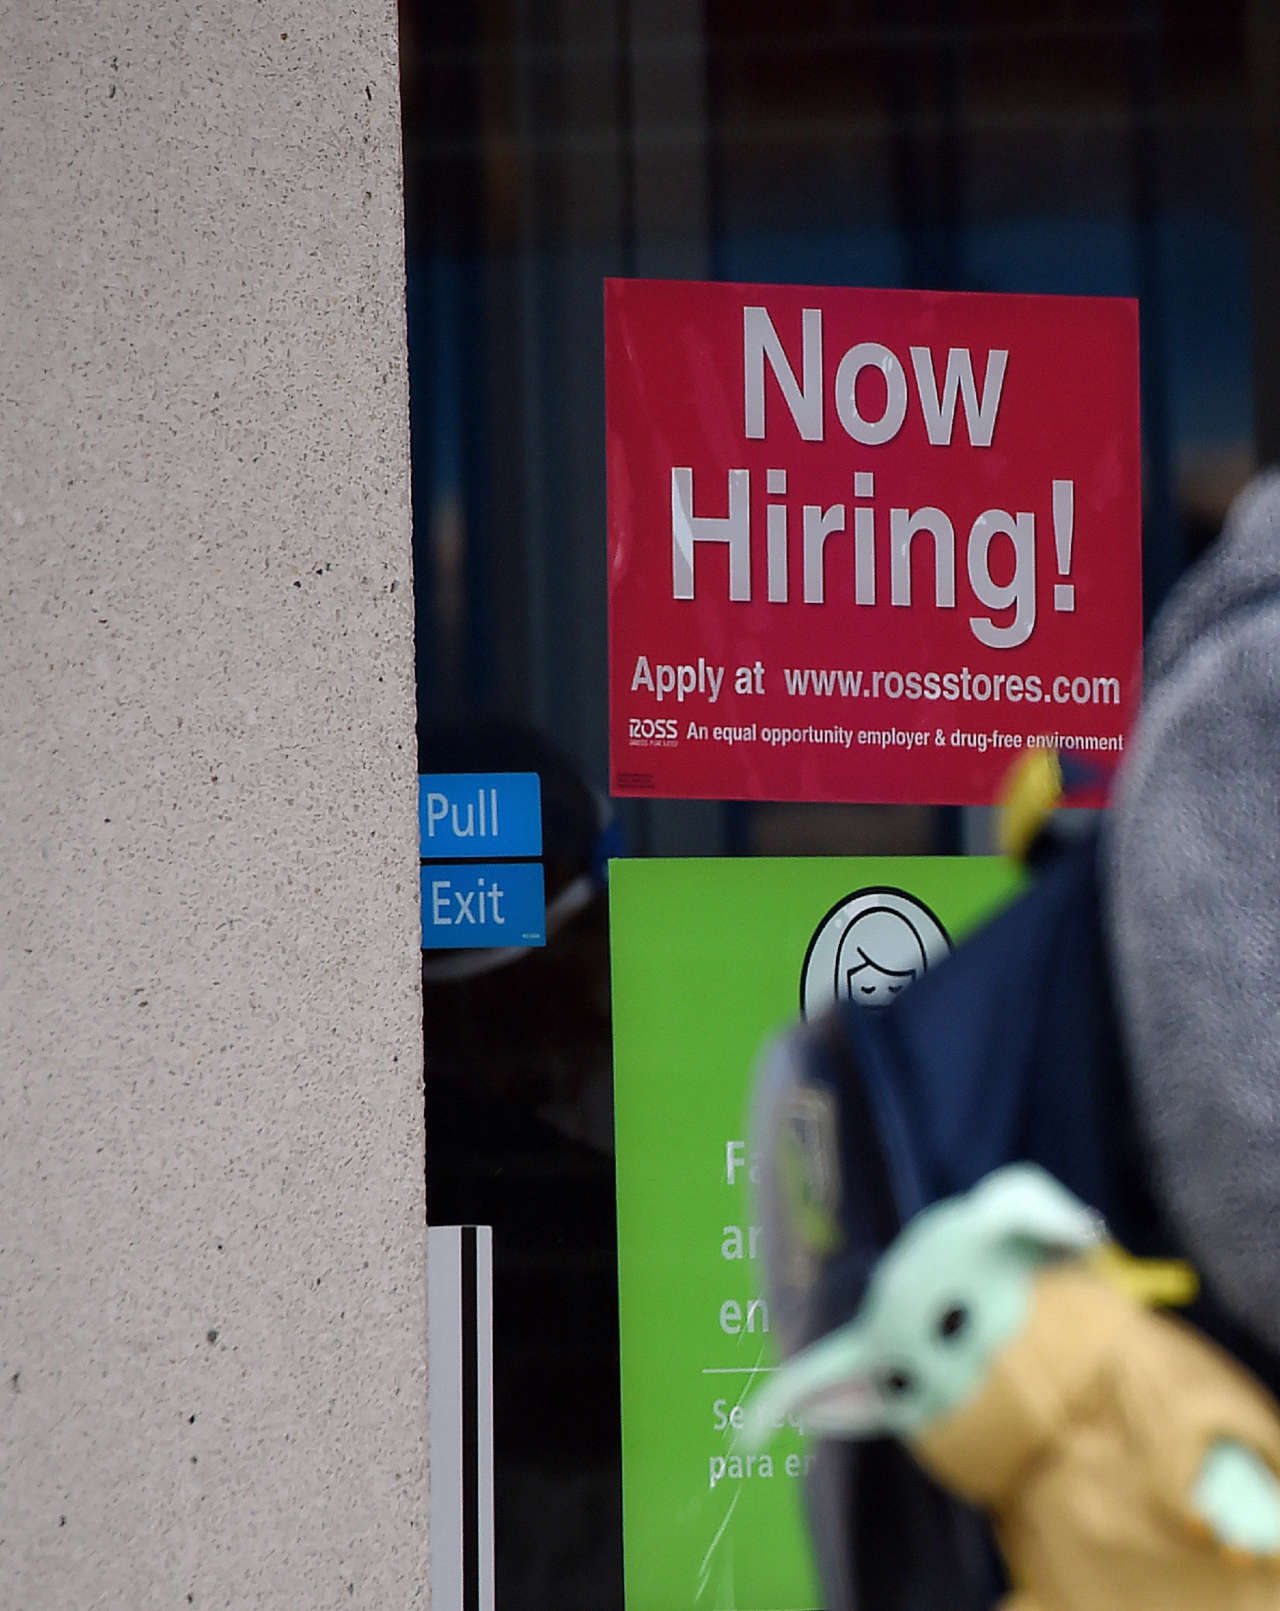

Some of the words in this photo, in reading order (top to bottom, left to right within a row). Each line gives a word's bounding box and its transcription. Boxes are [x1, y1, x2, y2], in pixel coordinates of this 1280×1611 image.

[744, 306, 1008, 446] Now
[672, 466, 1075, 649] Hiring!
[631, 655, 725, 703] Apply
[735, 661, 765, 695] at
[784, 667, 1121, 704] www.rossstores.com
[629, 719, 678, 739] ROSS
[686, 722, 708, 740] An
[713, 723, 757, 746] equal
[761, 726, 853, 749] opportunity
[857, 728, 930, 750] employer
[935, 729, 946, 746] &
[950, 729, 1022, 752] drug-free
[1026, 731, 1124, 750] environment
[427, 788, 499, 837] Pull
[432, 878, 505, 925] Exit
[709, 1454, 773, 1488] para
